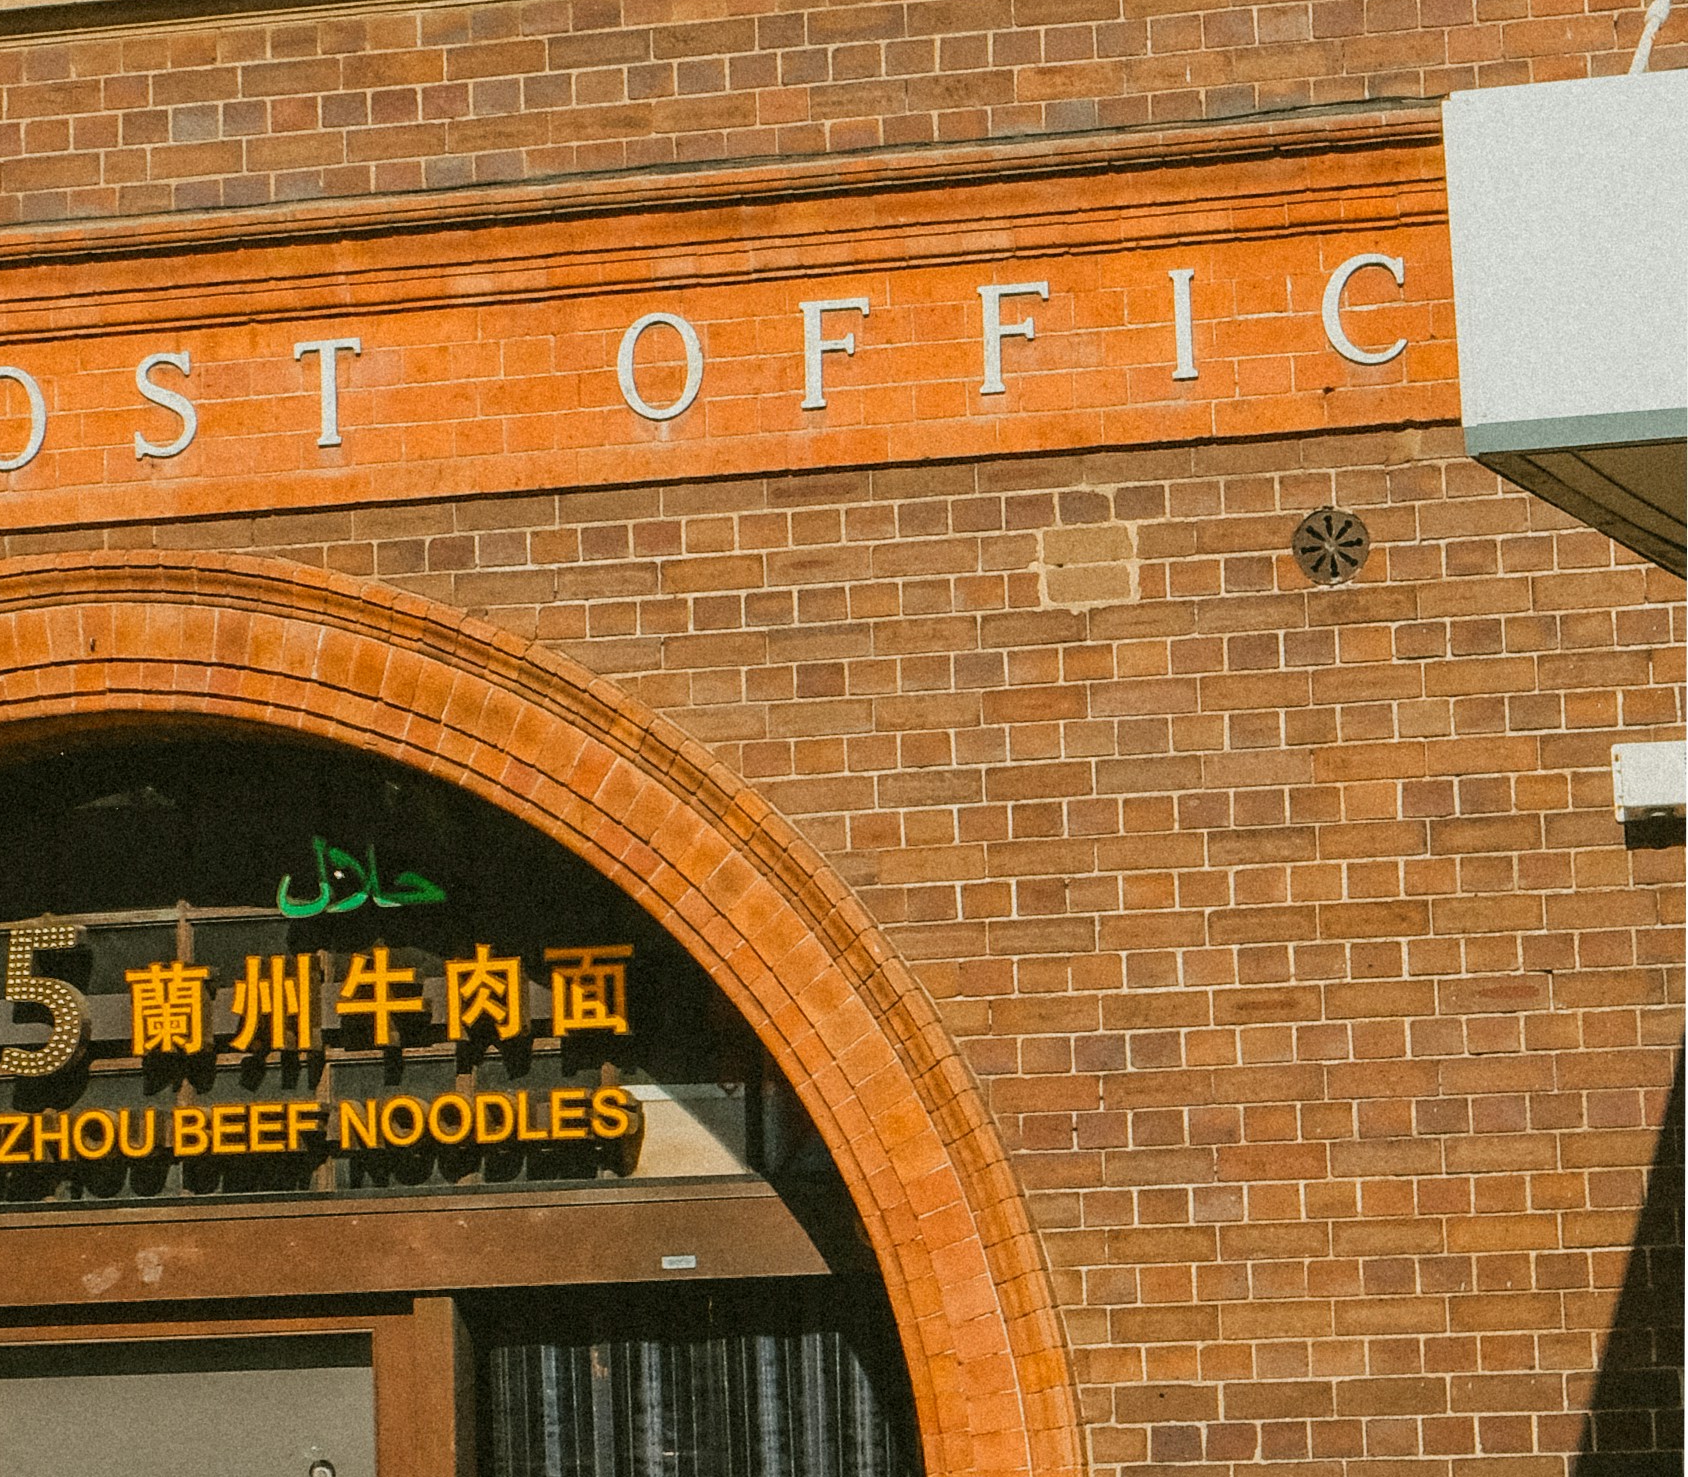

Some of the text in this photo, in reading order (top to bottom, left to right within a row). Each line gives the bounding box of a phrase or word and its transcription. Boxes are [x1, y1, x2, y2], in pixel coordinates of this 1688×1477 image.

[276, 834, 447, 918] حلال
[124, 944, 635, 1057] 蘭州牛肉面
[172, 1101, 321, 1158] BEEF
[338, 1087, 630, 1150] NOODLES
